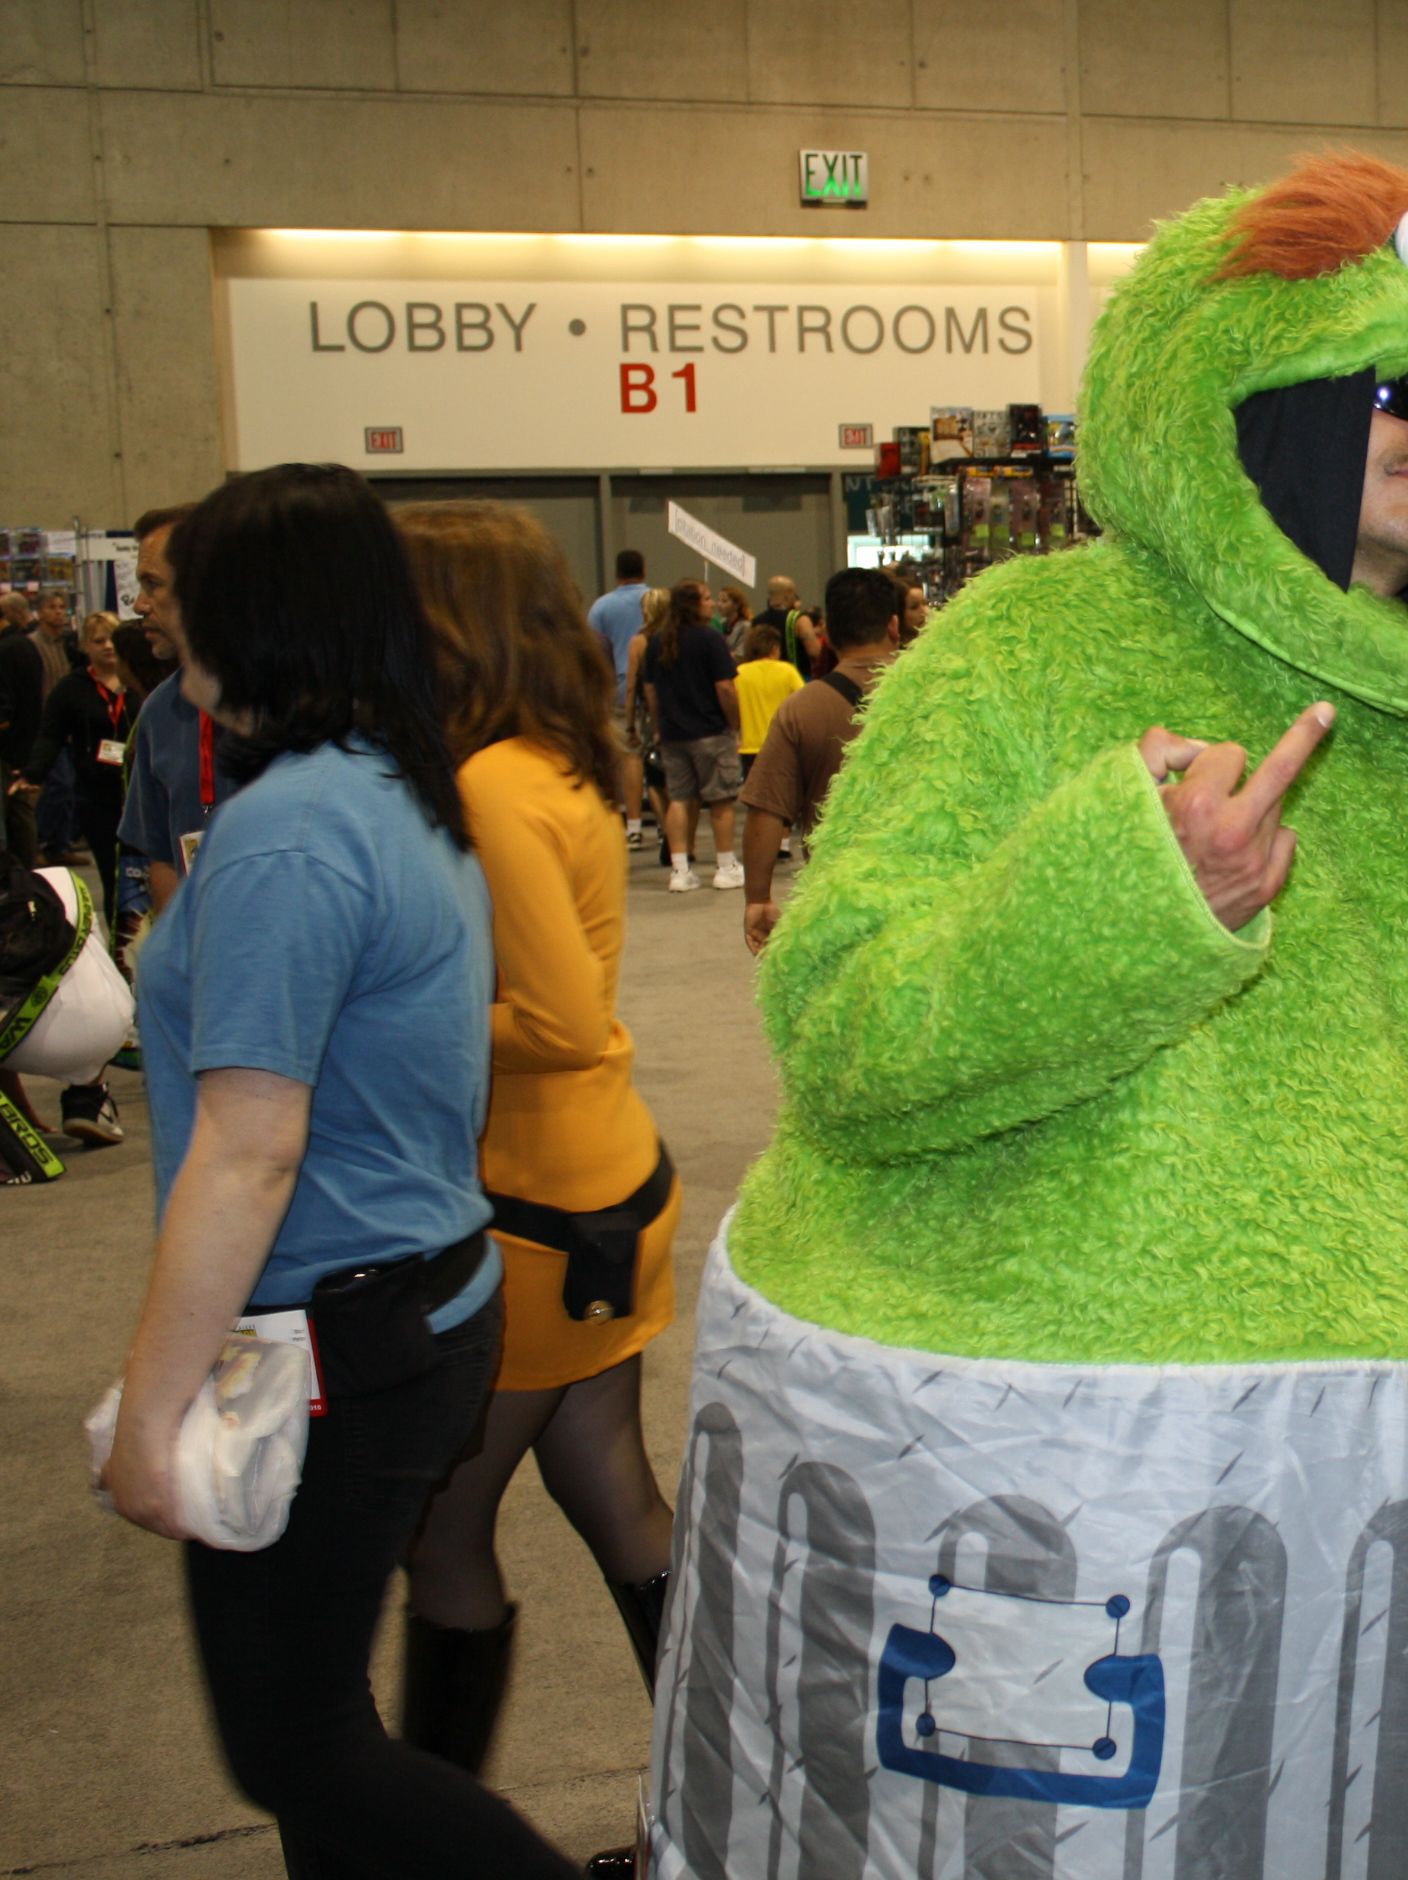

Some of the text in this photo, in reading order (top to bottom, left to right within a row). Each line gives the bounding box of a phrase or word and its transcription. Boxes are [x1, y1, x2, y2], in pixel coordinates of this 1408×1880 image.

[804, 153, 863, 198] EXIT
[309, 300, 1034, 355] LOBBY RESTROOMS
[619, 362, 699, 414] B1
[370, 431, 397, 449] EXIT
[844, 428, 867, 446] EXIT
